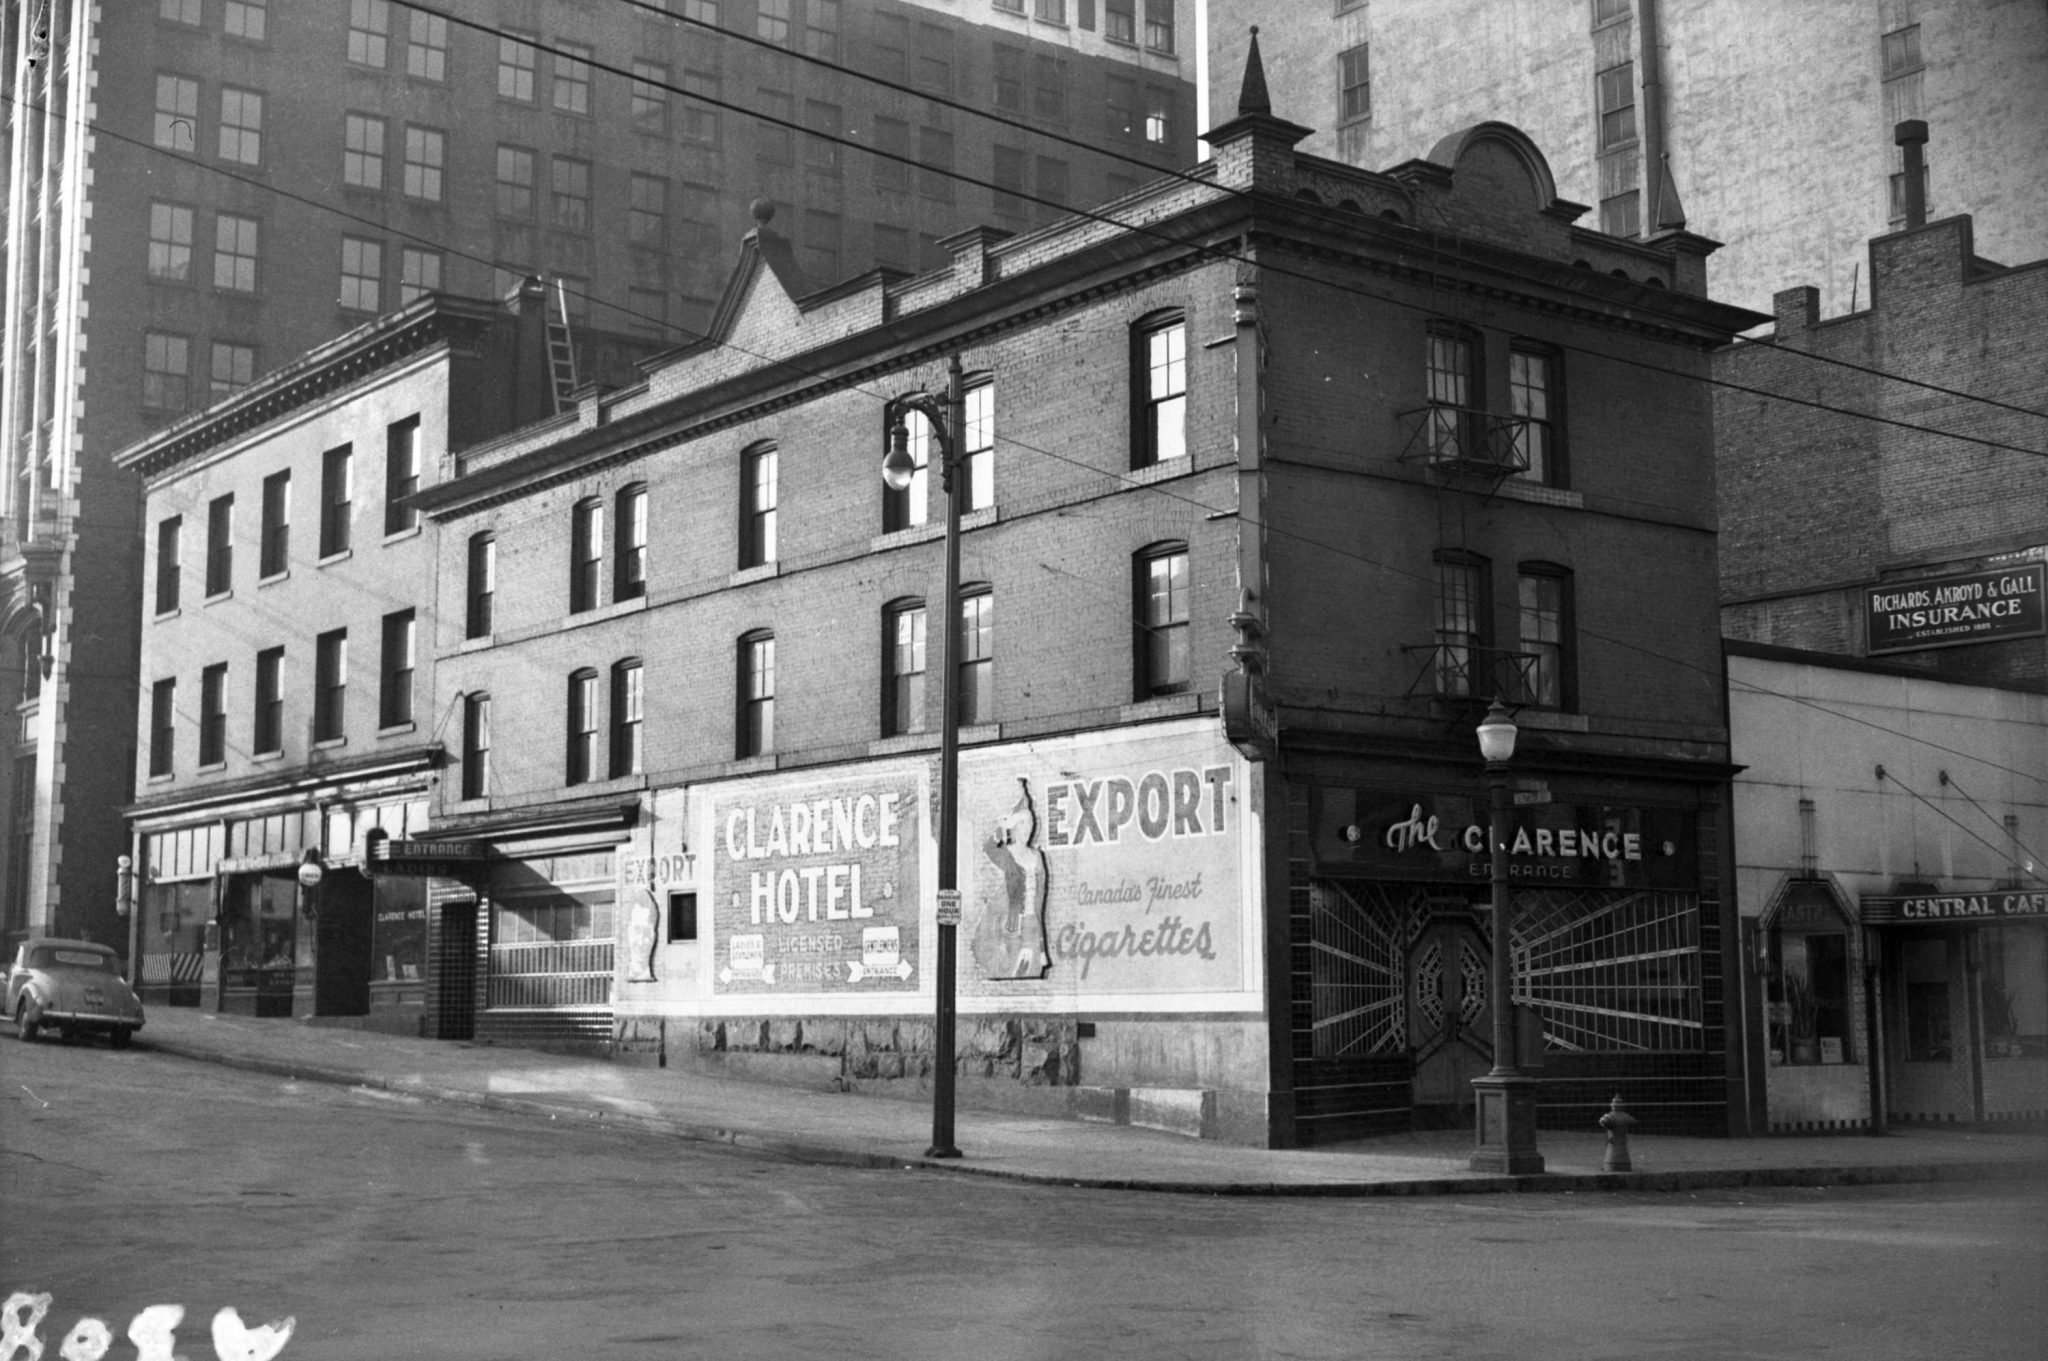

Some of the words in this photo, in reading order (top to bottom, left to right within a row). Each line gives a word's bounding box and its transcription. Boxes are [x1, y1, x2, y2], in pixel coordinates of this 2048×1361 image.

[1934, 583, 1983, 605] AKROYD
[1987, 581, 1998, 598] &
[2001, 576, 2036, 596] GALL
[1889, 598, 2022, 630] INSURANCE
[1916, 625, 1970, 638] ESTABLISHED
[1046, 764, 1232, 848] EXPORT
[726, 793, 900, 861] CLARENCE
[1387, 803, 1442, 853] The
[404, 843, 472, 856] ENTRANCE
[625, 854, 696, 884] EXPORT
[1469, 863, 1572, 879] ENRANCE
[751, 864, 874, 925] HOTEL
[1144, 872, 1203, 915] Finest
[1903, 896, 1995, 918] CENTRAL
[778, 935, 843, 953] LICENSED
[1056, 916, 1216, 980] Cigarettes
[780, 962, 841, 984] PREMISES
[863, 966, 897, 976] ENTRANCE
